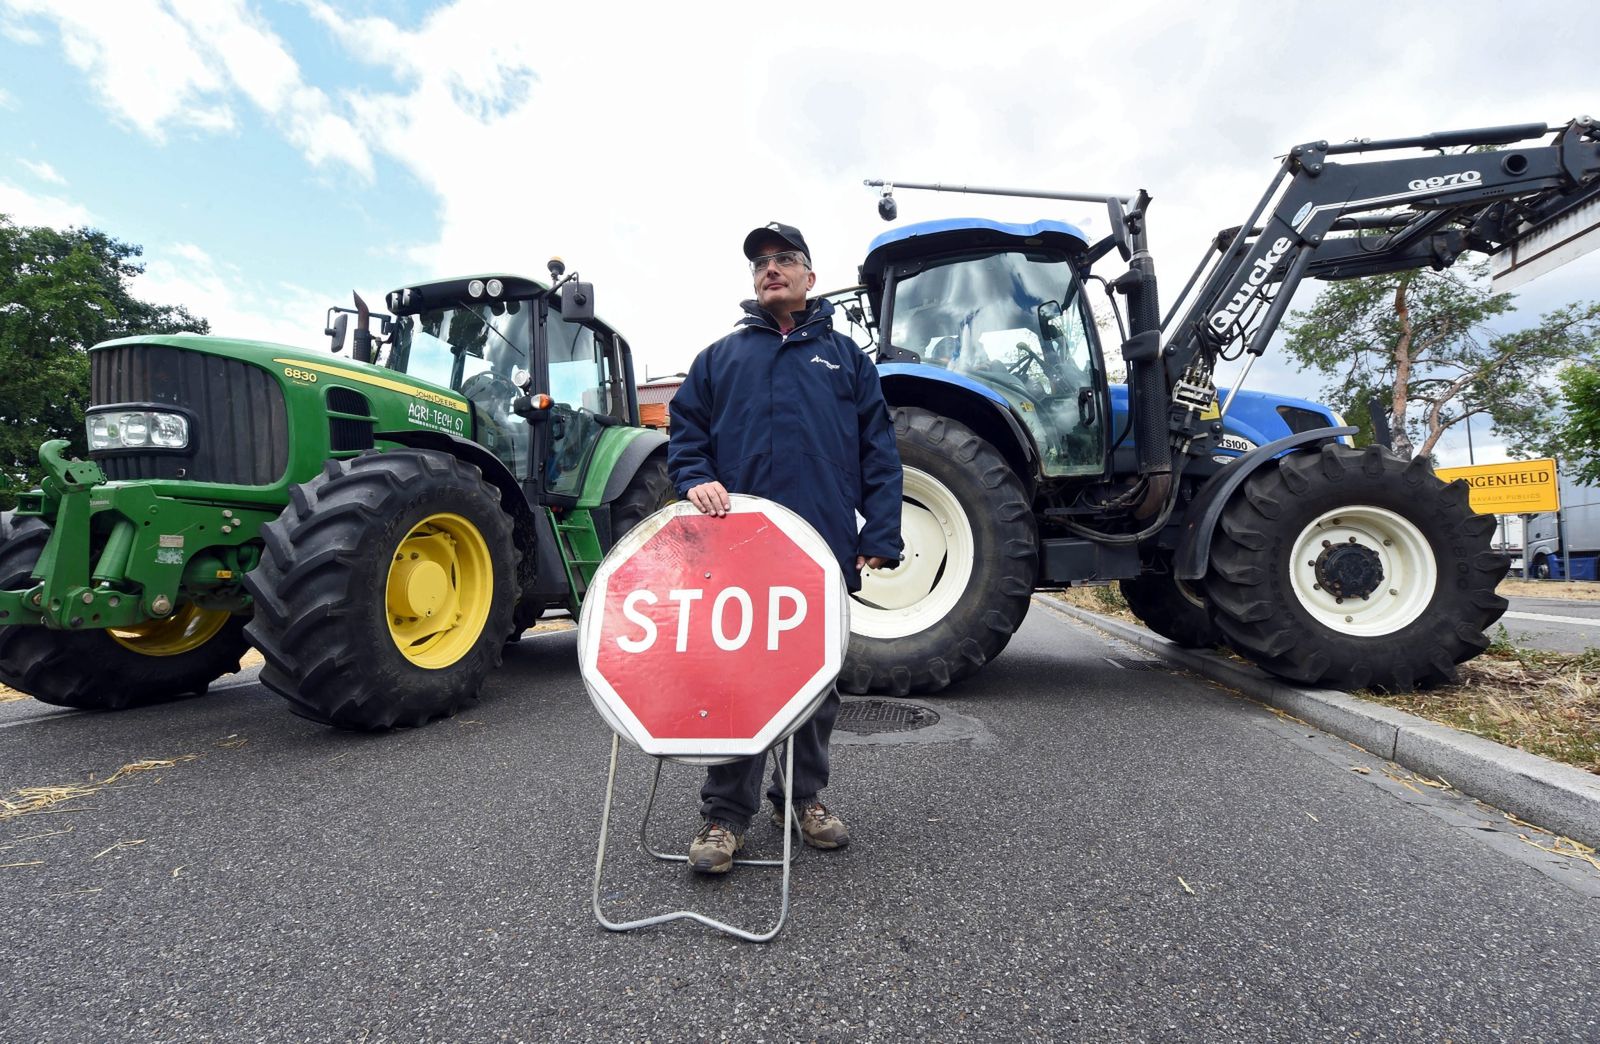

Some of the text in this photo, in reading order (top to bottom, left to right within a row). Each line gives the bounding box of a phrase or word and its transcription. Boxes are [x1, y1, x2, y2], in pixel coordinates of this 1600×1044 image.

[1408, 170, 1481, 191] Q970
[1209, 237, 1292, 334] Quicke
[284, 367, 317, 382] 6830
[416, 390, 457, 408] JOHN DEERE
[408, 402, 453, 429] AGRI-TECH
[615, 586, 808, 653] STOP
